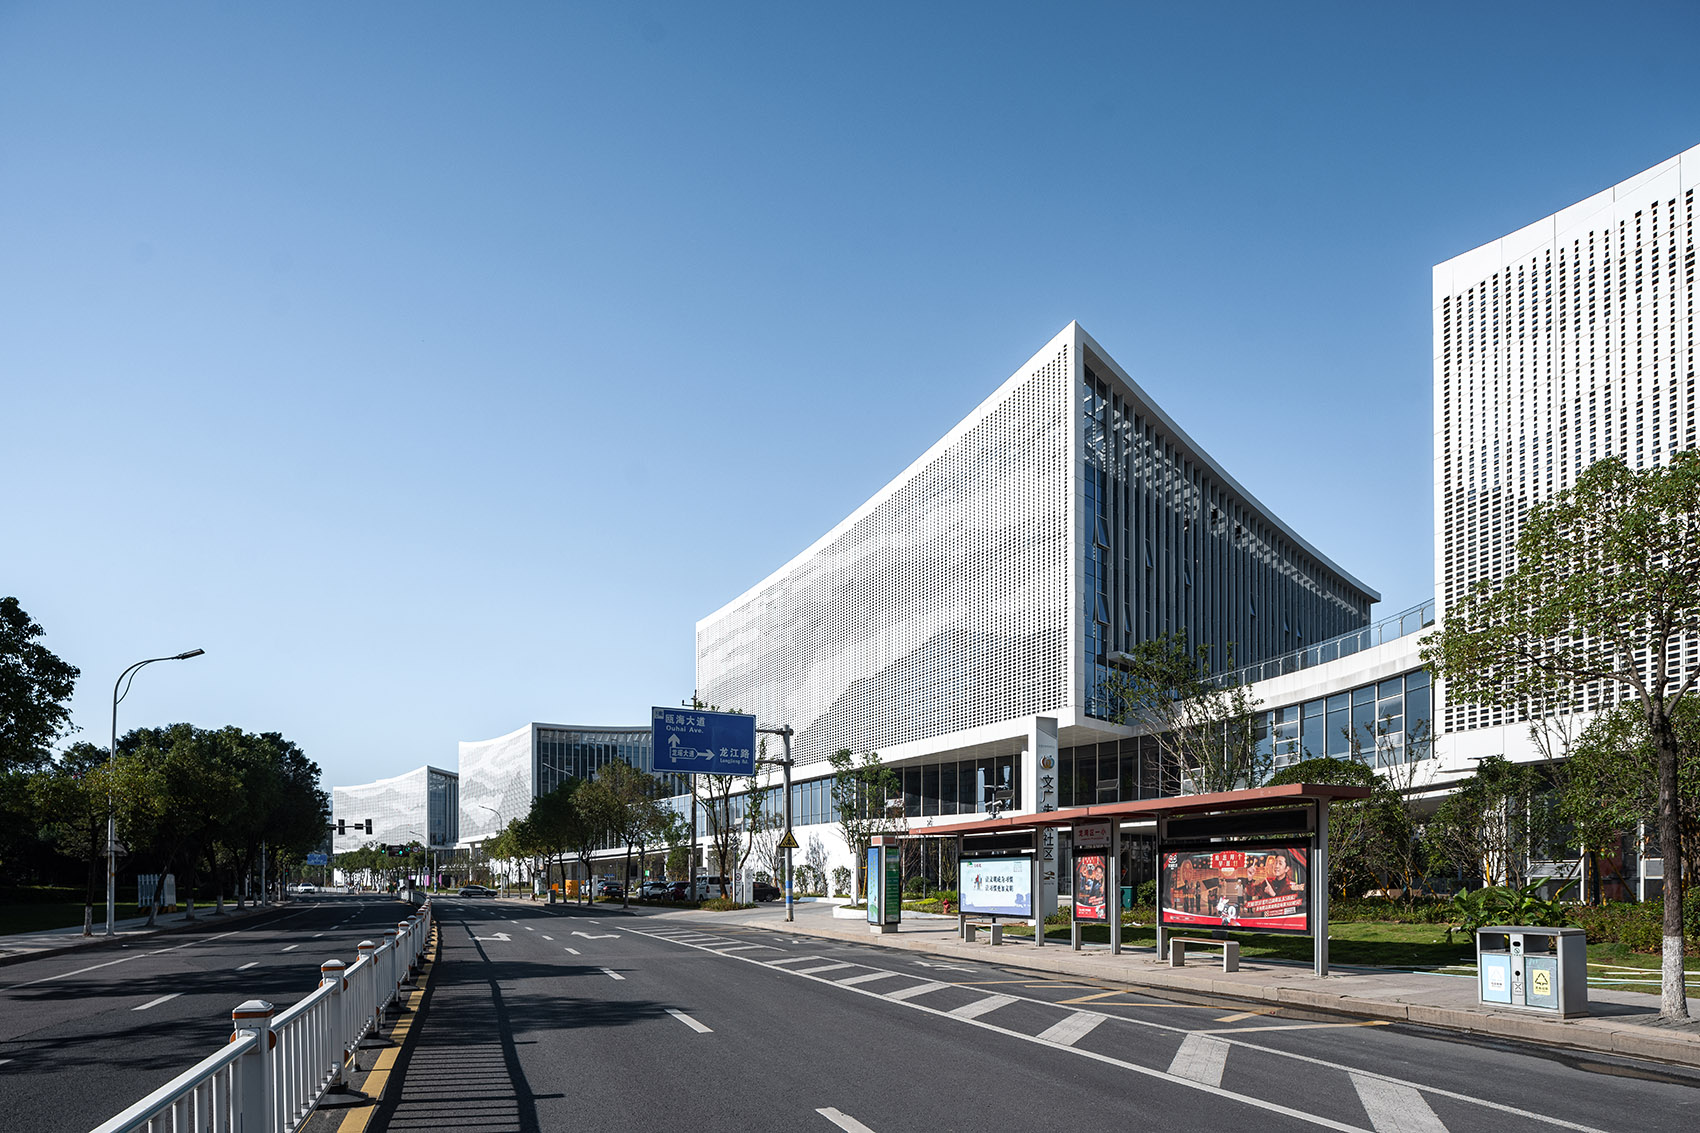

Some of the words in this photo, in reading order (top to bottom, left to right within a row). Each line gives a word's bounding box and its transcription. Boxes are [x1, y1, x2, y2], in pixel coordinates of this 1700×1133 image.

[665, 714, 705, 727] 瓯海大道
[719, 747, 749, 758] 龙江路
